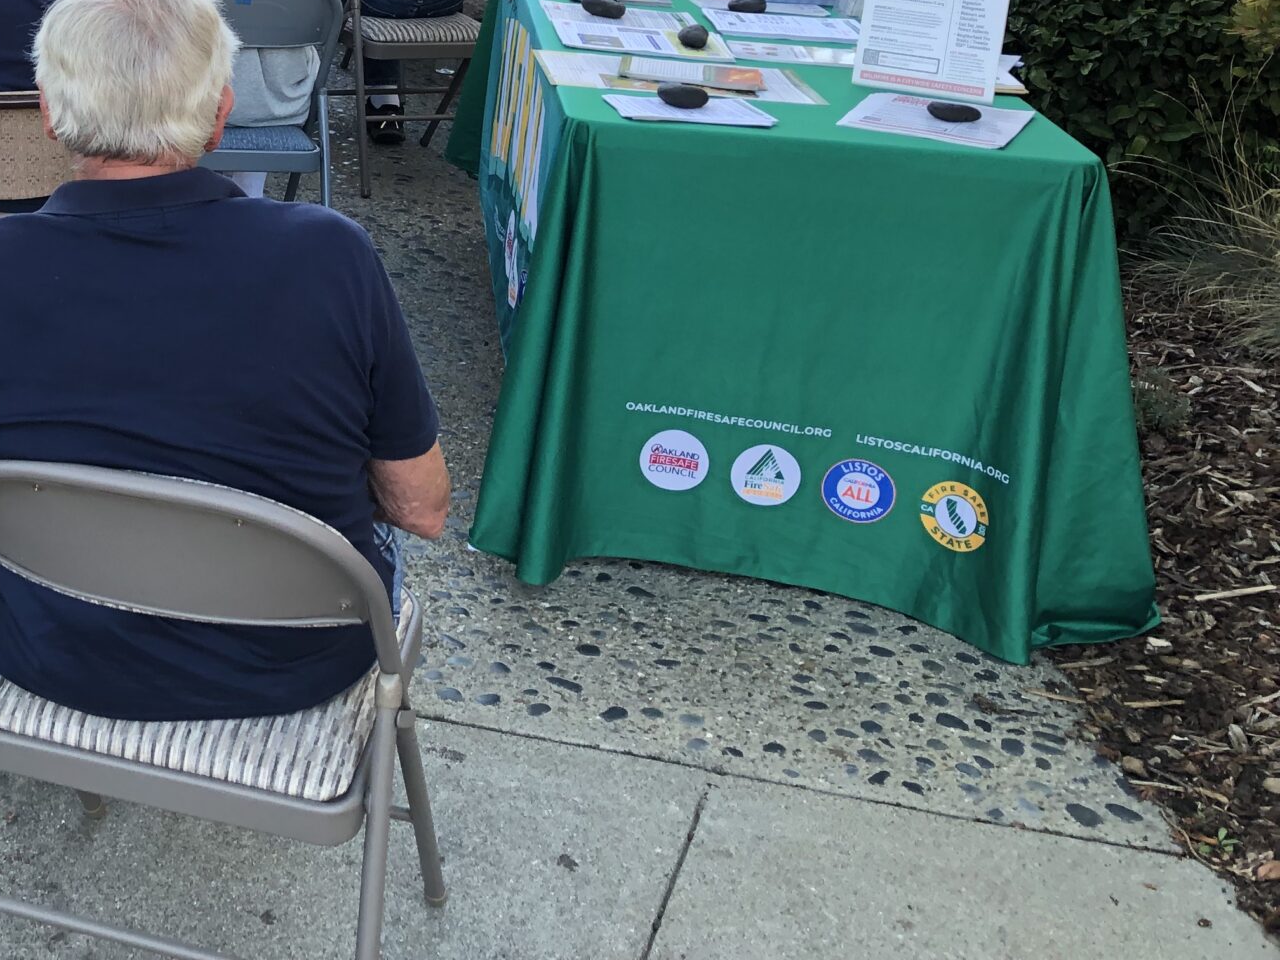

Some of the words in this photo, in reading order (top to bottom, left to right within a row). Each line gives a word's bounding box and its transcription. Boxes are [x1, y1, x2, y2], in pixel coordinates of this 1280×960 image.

[626, 401, 832, 438] OAKLANDFIRESAFECOUNCIL.ORG
[651, 443, 700, 461] OAKLAND
[856, 434, 1010, 484] LISTOSCALIFORNIA.ORG
[648, 464, 696, 479] COUNCIL
[650, 455, 698, 470] FIRESAFE
[841, 462, 885, 482] LISTOS
[743, 480, 764, 490] Fire
[841, 485, 874, 504] ALL
[829, 497, 884, 520] CALIFORNIA
[920, 504, 934, 513] CA
[928, 485, 956, 500] FIRE
[963, 489, 986, 519] SAFE
[930, 525, 973, 550] STATE
